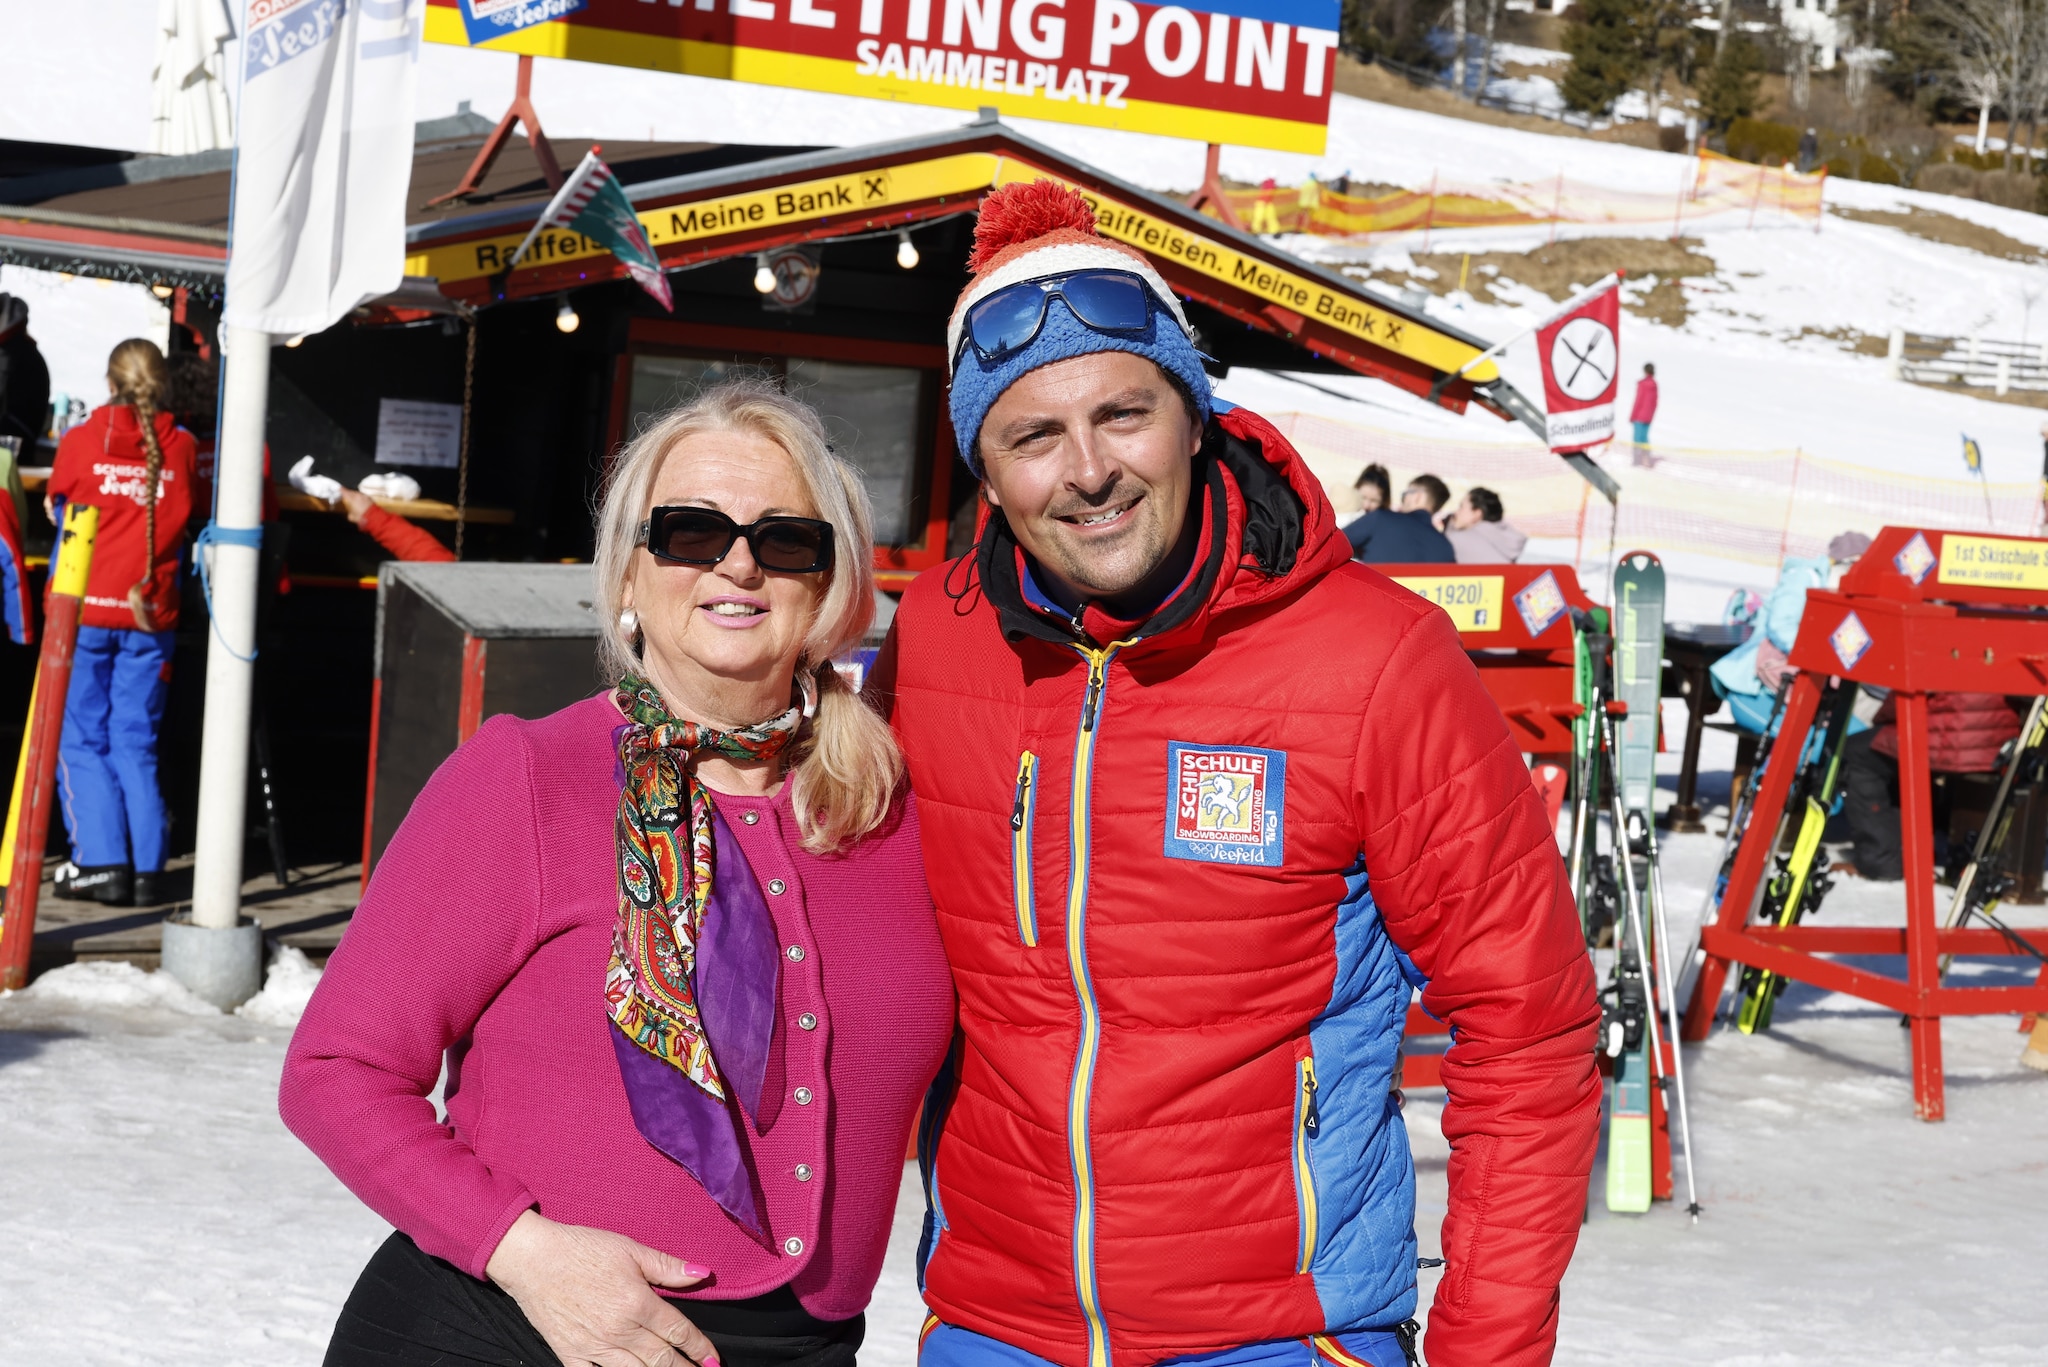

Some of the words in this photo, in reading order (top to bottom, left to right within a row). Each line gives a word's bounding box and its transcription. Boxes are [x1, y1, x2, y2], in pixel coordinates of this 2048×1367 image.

[636, 0, 1066, 59] TING
[1090, 0, 1340, 97] POINT
[856, 39, 1130, 109] SAMMELPLATZ
[477, 222, 660, 270] Raiffei.
[671, 204, 764, 236] Meine
[777, 184, 852, 217] Bank
[1233, 259, 1308, 306] Meine
[1316, 293, 1375, 334] Bank
[93, 463, 174, 481] SCHISCHLE
[99, 474, 164, 499] Seefed
[1955, 545, 1974, 562] 1st
[1183, 755, 1263, 774] SCHULE
[1181, 771, 1198, 820] SCHI
[1253, 789, 1263, 832] CARVING
[1179, 829, 1260, 843] SNOWBOARDING
[1265, 810, 1278, 846] Tirol
[1211, 844, 1265, 864] Seefeld
